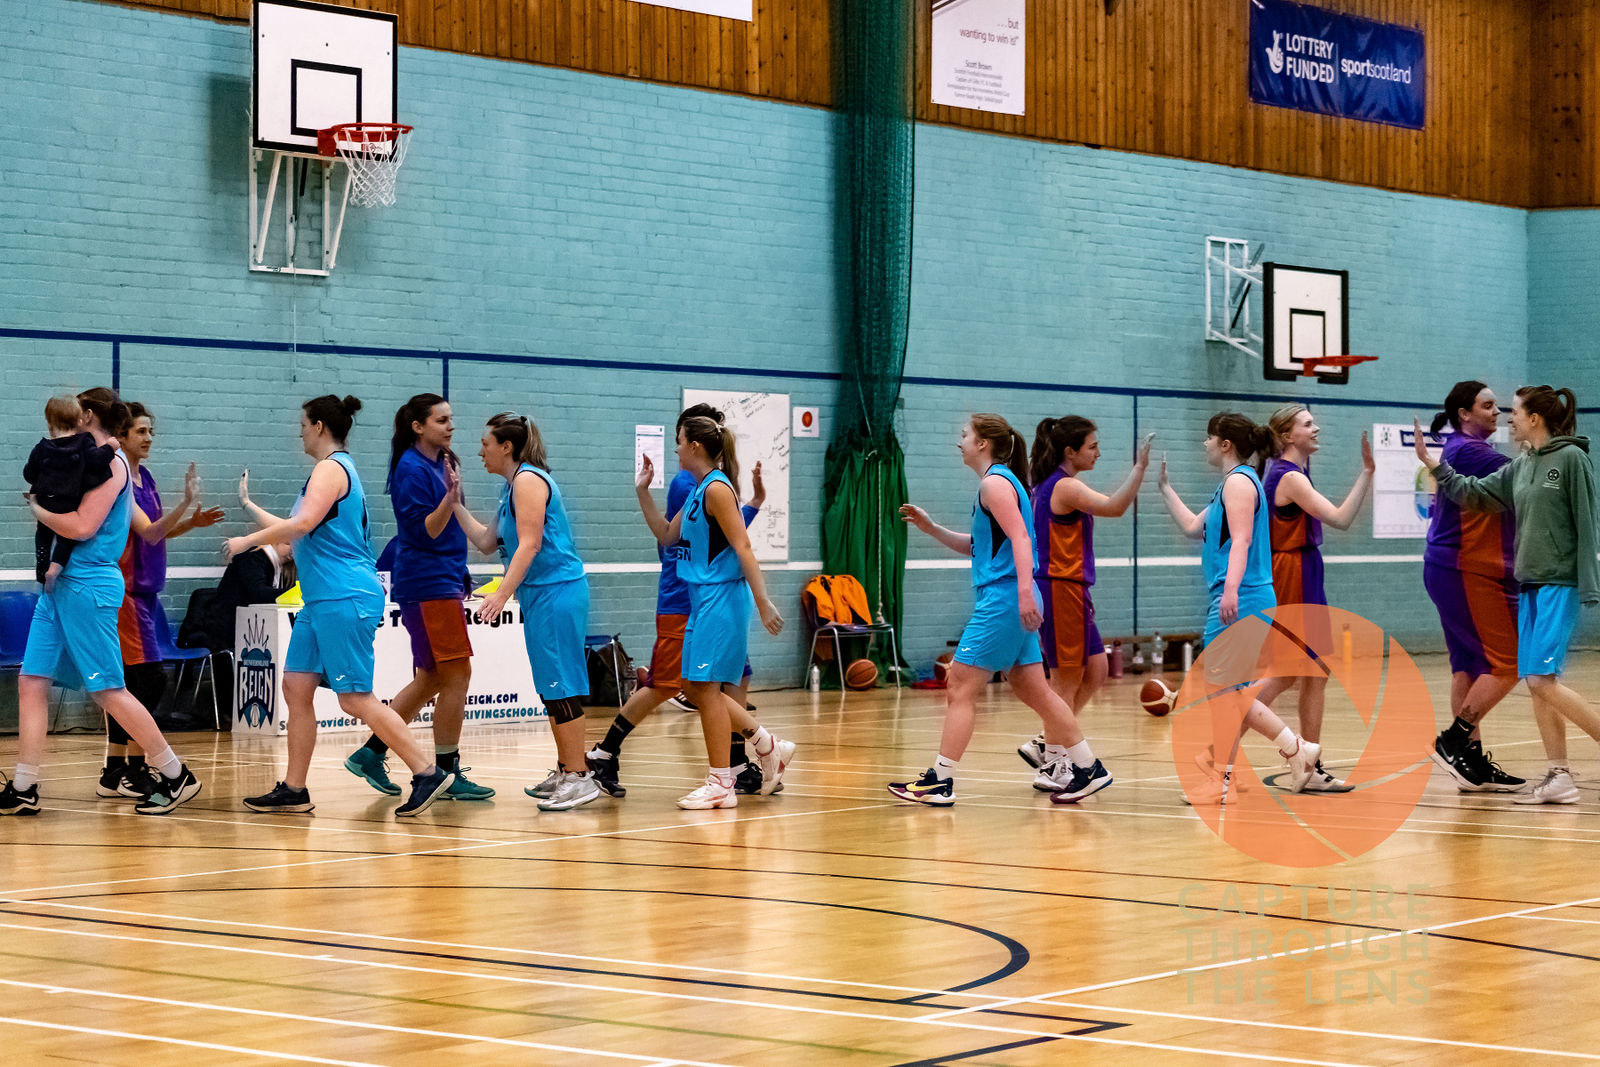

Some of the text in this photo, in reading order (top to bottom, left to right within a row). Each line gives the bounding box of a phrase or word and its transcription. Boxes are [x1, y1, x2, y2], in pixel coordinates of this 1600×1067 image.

[959, 28, 987, 43] wanting
[988, 32, 995, 42] to
[996, 35, 1009, 44] win
[1286, 32, 1334, 60] LOTTERY
[1286, 56, 1334, 84] FUNDED
[1341, 58, 1411, 84] sportscotland
[239, 666, 274, 713] REIGN
[315, 716, 358, 729] rovided
